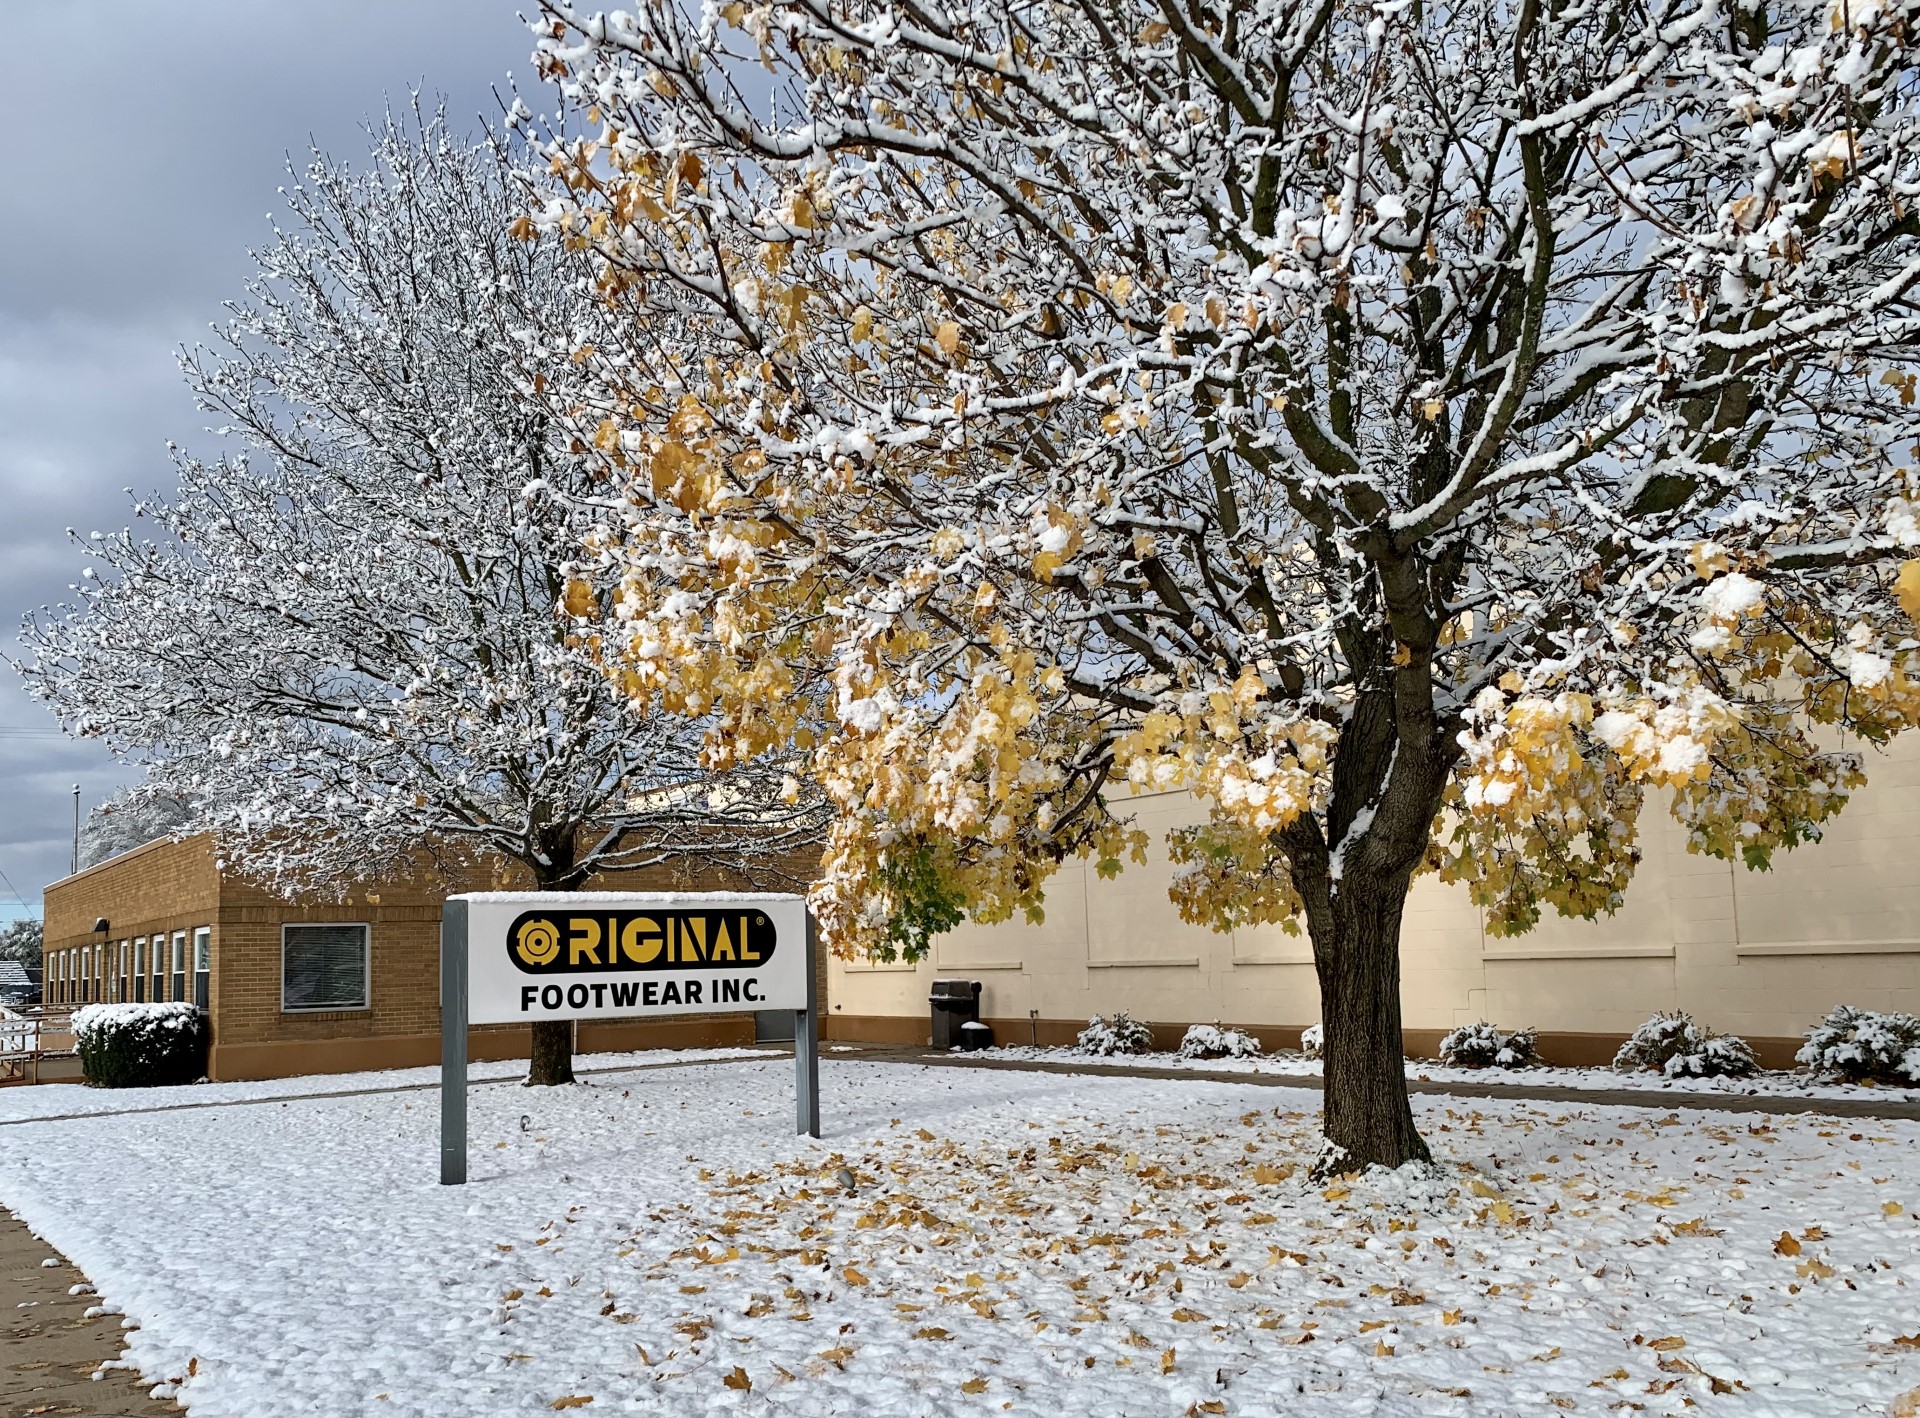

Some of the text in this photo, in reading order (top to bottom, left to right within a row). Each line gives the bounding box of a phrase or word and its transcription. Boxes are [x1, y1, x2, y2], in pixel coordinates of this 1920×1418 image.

[516, 916, 761, 965] ORIGINAL
[521, 978, 766, 1011] FOOTWEAR INC.
